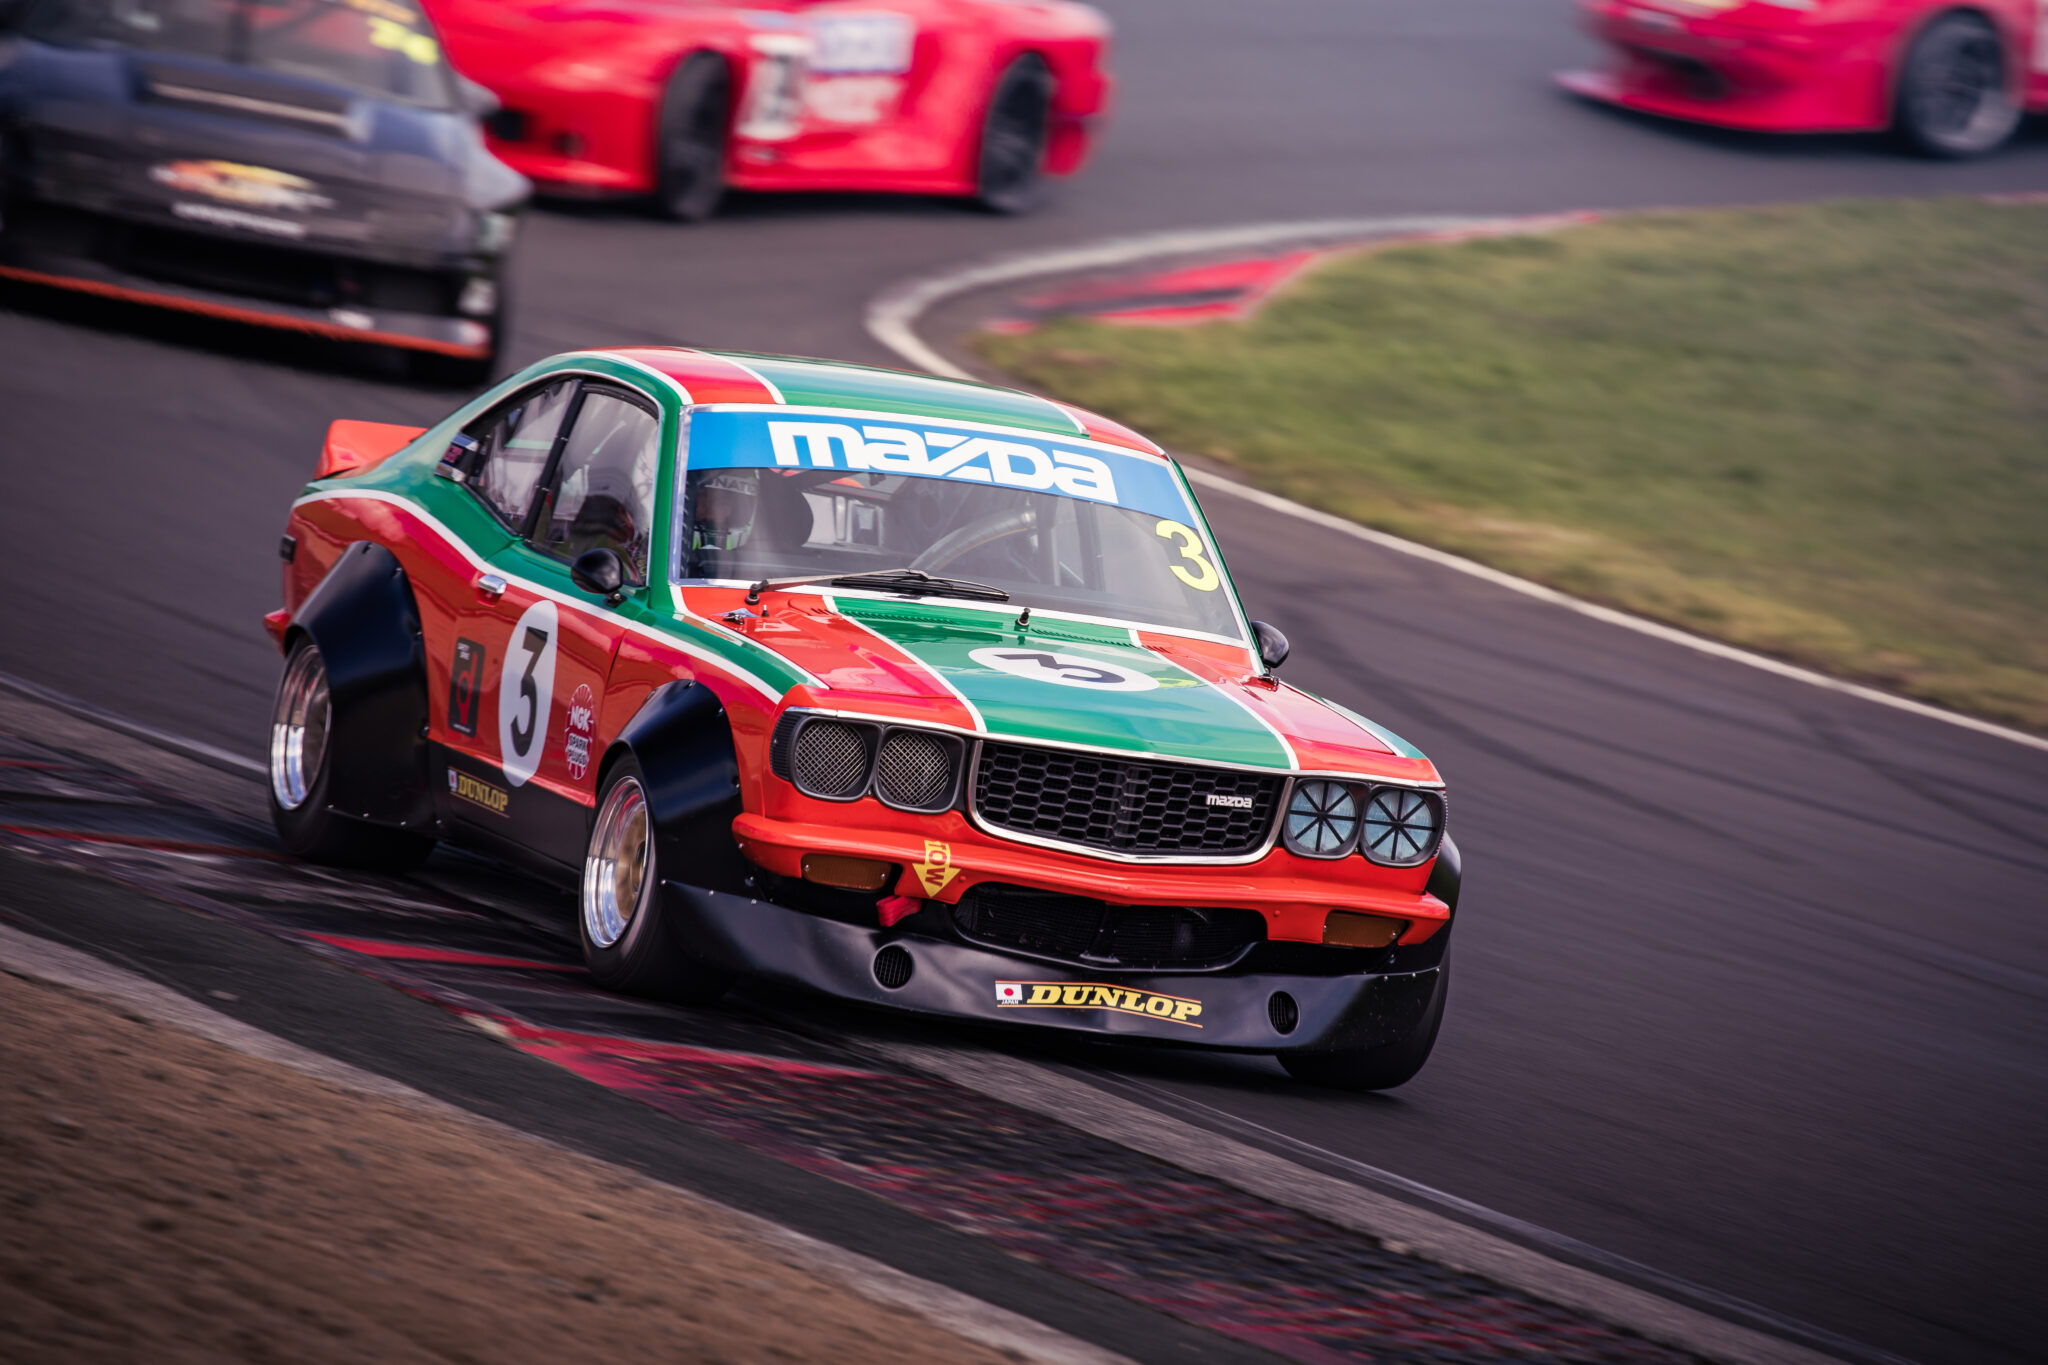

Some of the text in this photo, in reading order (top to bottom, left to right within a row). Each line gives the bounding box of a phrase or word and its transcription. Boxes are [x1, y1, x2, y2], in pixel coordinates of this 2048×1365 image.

[1155, 519, 1220, 592] 3
[993, 653, 1126, 684] 3
[511, 626, 549, 757] 3
[570, 704, 592, 733] NGK
[458, 775, 508, 811] DUNLOP
[925, 844, 947, 887] TOW
[1026, 985, 1202, 1020] DUNLOP
